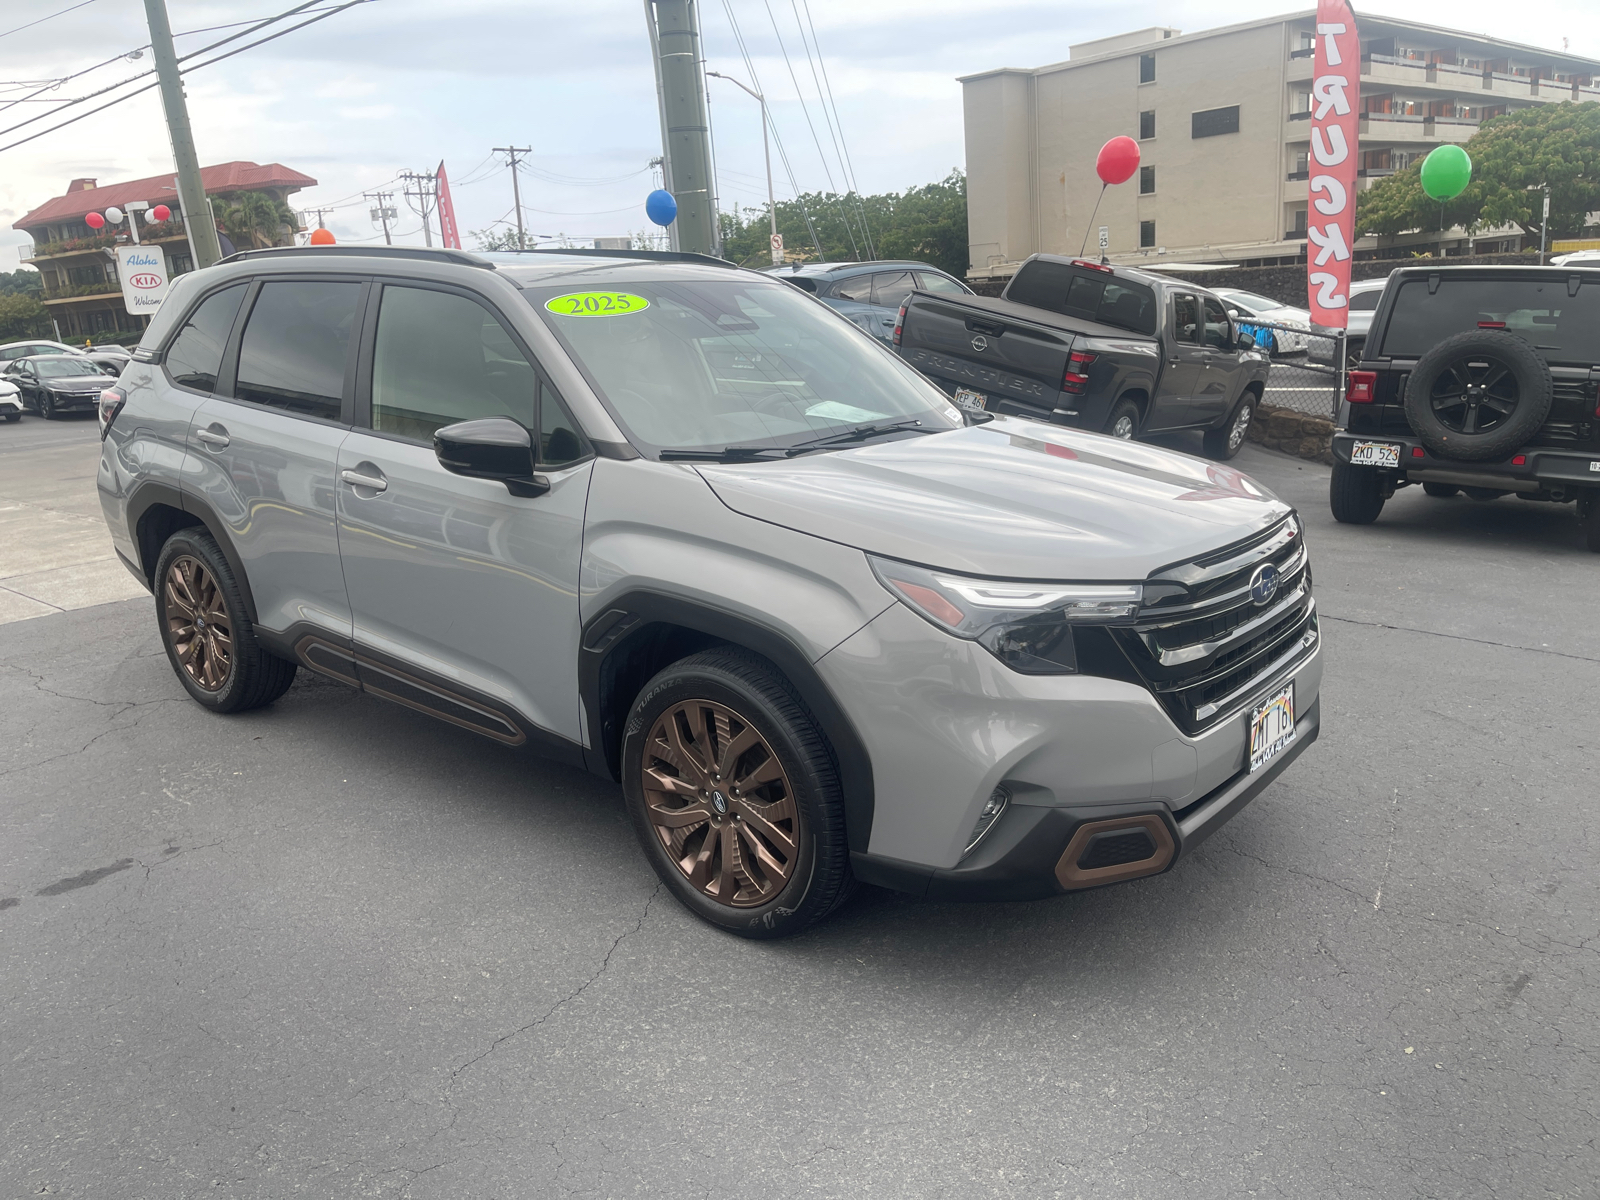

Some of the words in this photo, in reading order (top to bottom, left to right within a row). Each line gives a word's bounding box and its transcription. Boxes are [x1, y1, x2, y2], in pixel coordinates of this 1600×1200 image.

[1100, 237, 1108, 247] 25
[126, 254, 158, 266] Aloha
[135, 276, 158, 286] KIA
[134, 294, 162, 306] Welcom
[566, 295, 631, 314] 2025
[1353, 446, 1373, 459] ZKD
[1379, 447, 1399, 462] 523
[636, 679, 683, 713] TURANZA
[1277, 695, 1292, 735] 161
